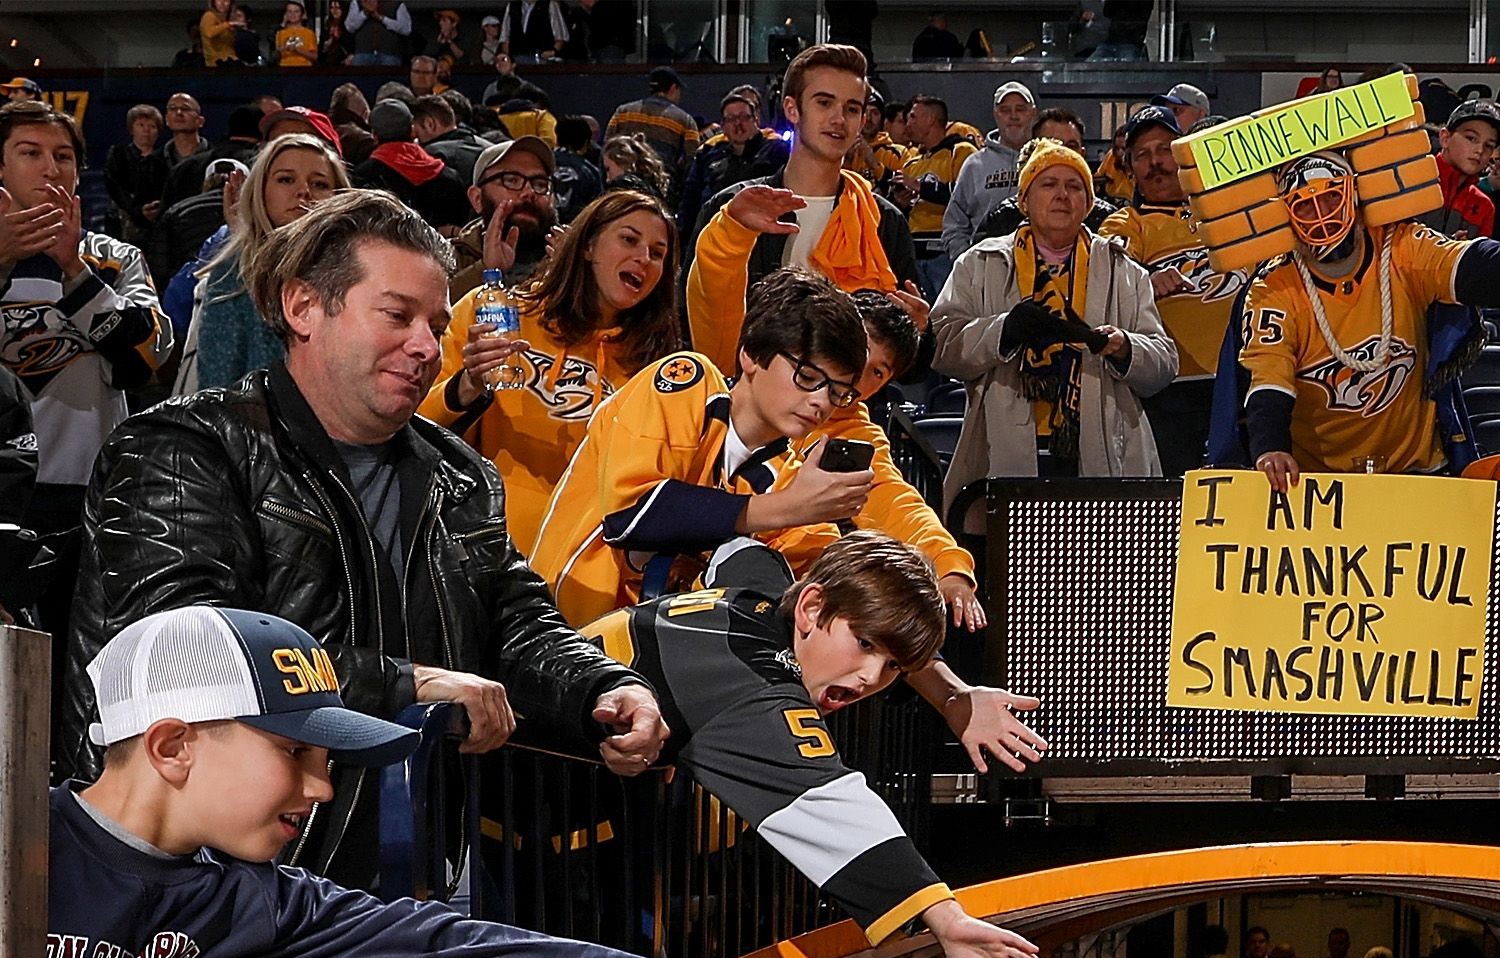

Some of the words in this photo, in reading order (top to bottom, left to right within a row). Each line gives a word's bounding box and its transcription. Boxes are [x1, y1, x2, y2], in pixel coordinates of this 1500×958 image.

[1195, 476, 1233, 527] I
[1266, 478, 1344, 531] AM
[1205, 542, 1473, 606] THANKFUL
[1301, 602, 1385, 643] FOR
[1182, 631, 1477, 707] SMASHVILLE
